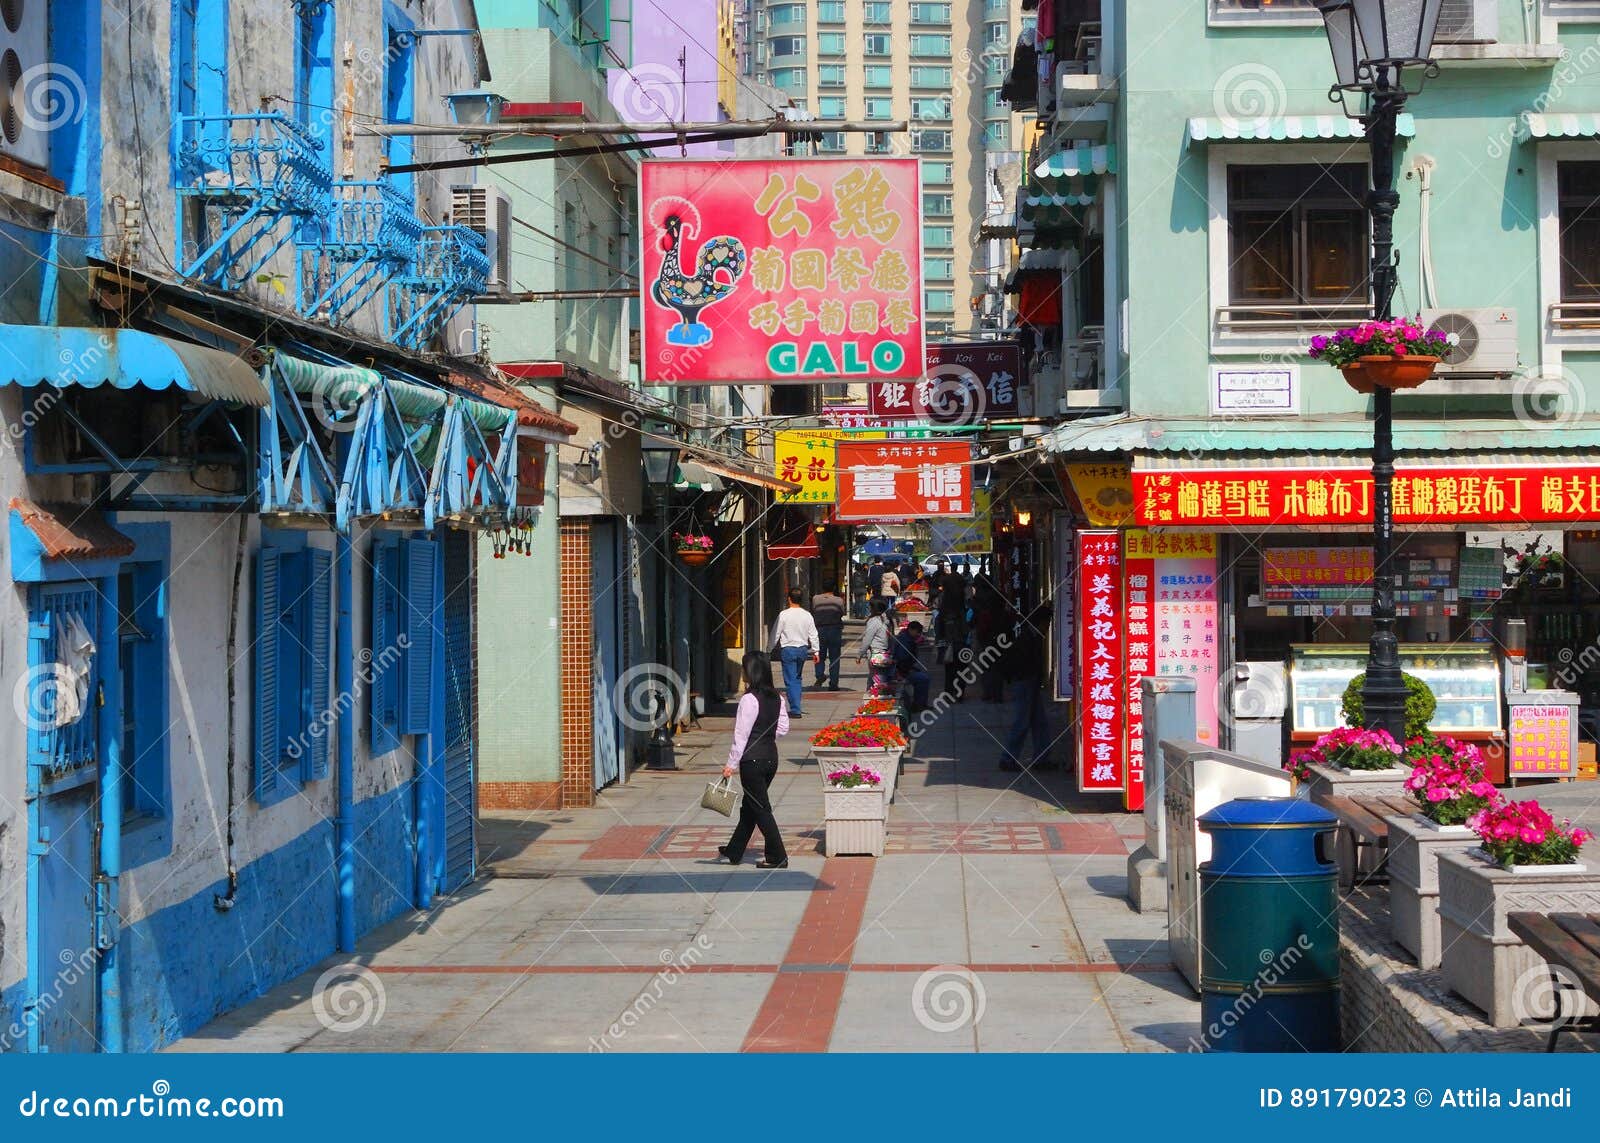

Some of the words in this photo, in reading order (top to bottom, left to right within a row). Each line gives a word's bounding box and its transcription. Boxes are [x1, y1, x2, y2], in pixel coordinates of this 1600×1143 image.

[749, 247, 911, 293] 葡國餐廳
[749, 299, 917, 336] 巧手葡國餐
[767, 340, 904, 375] GALO
[1144, 475, 1157, 521] 八十多年
[1158, 475, 1172, 521] 老字號
[1178, 480, 1270, 518] 榴蓮雪糕
[1283, 479, 1375, 517] 木糠布丁
